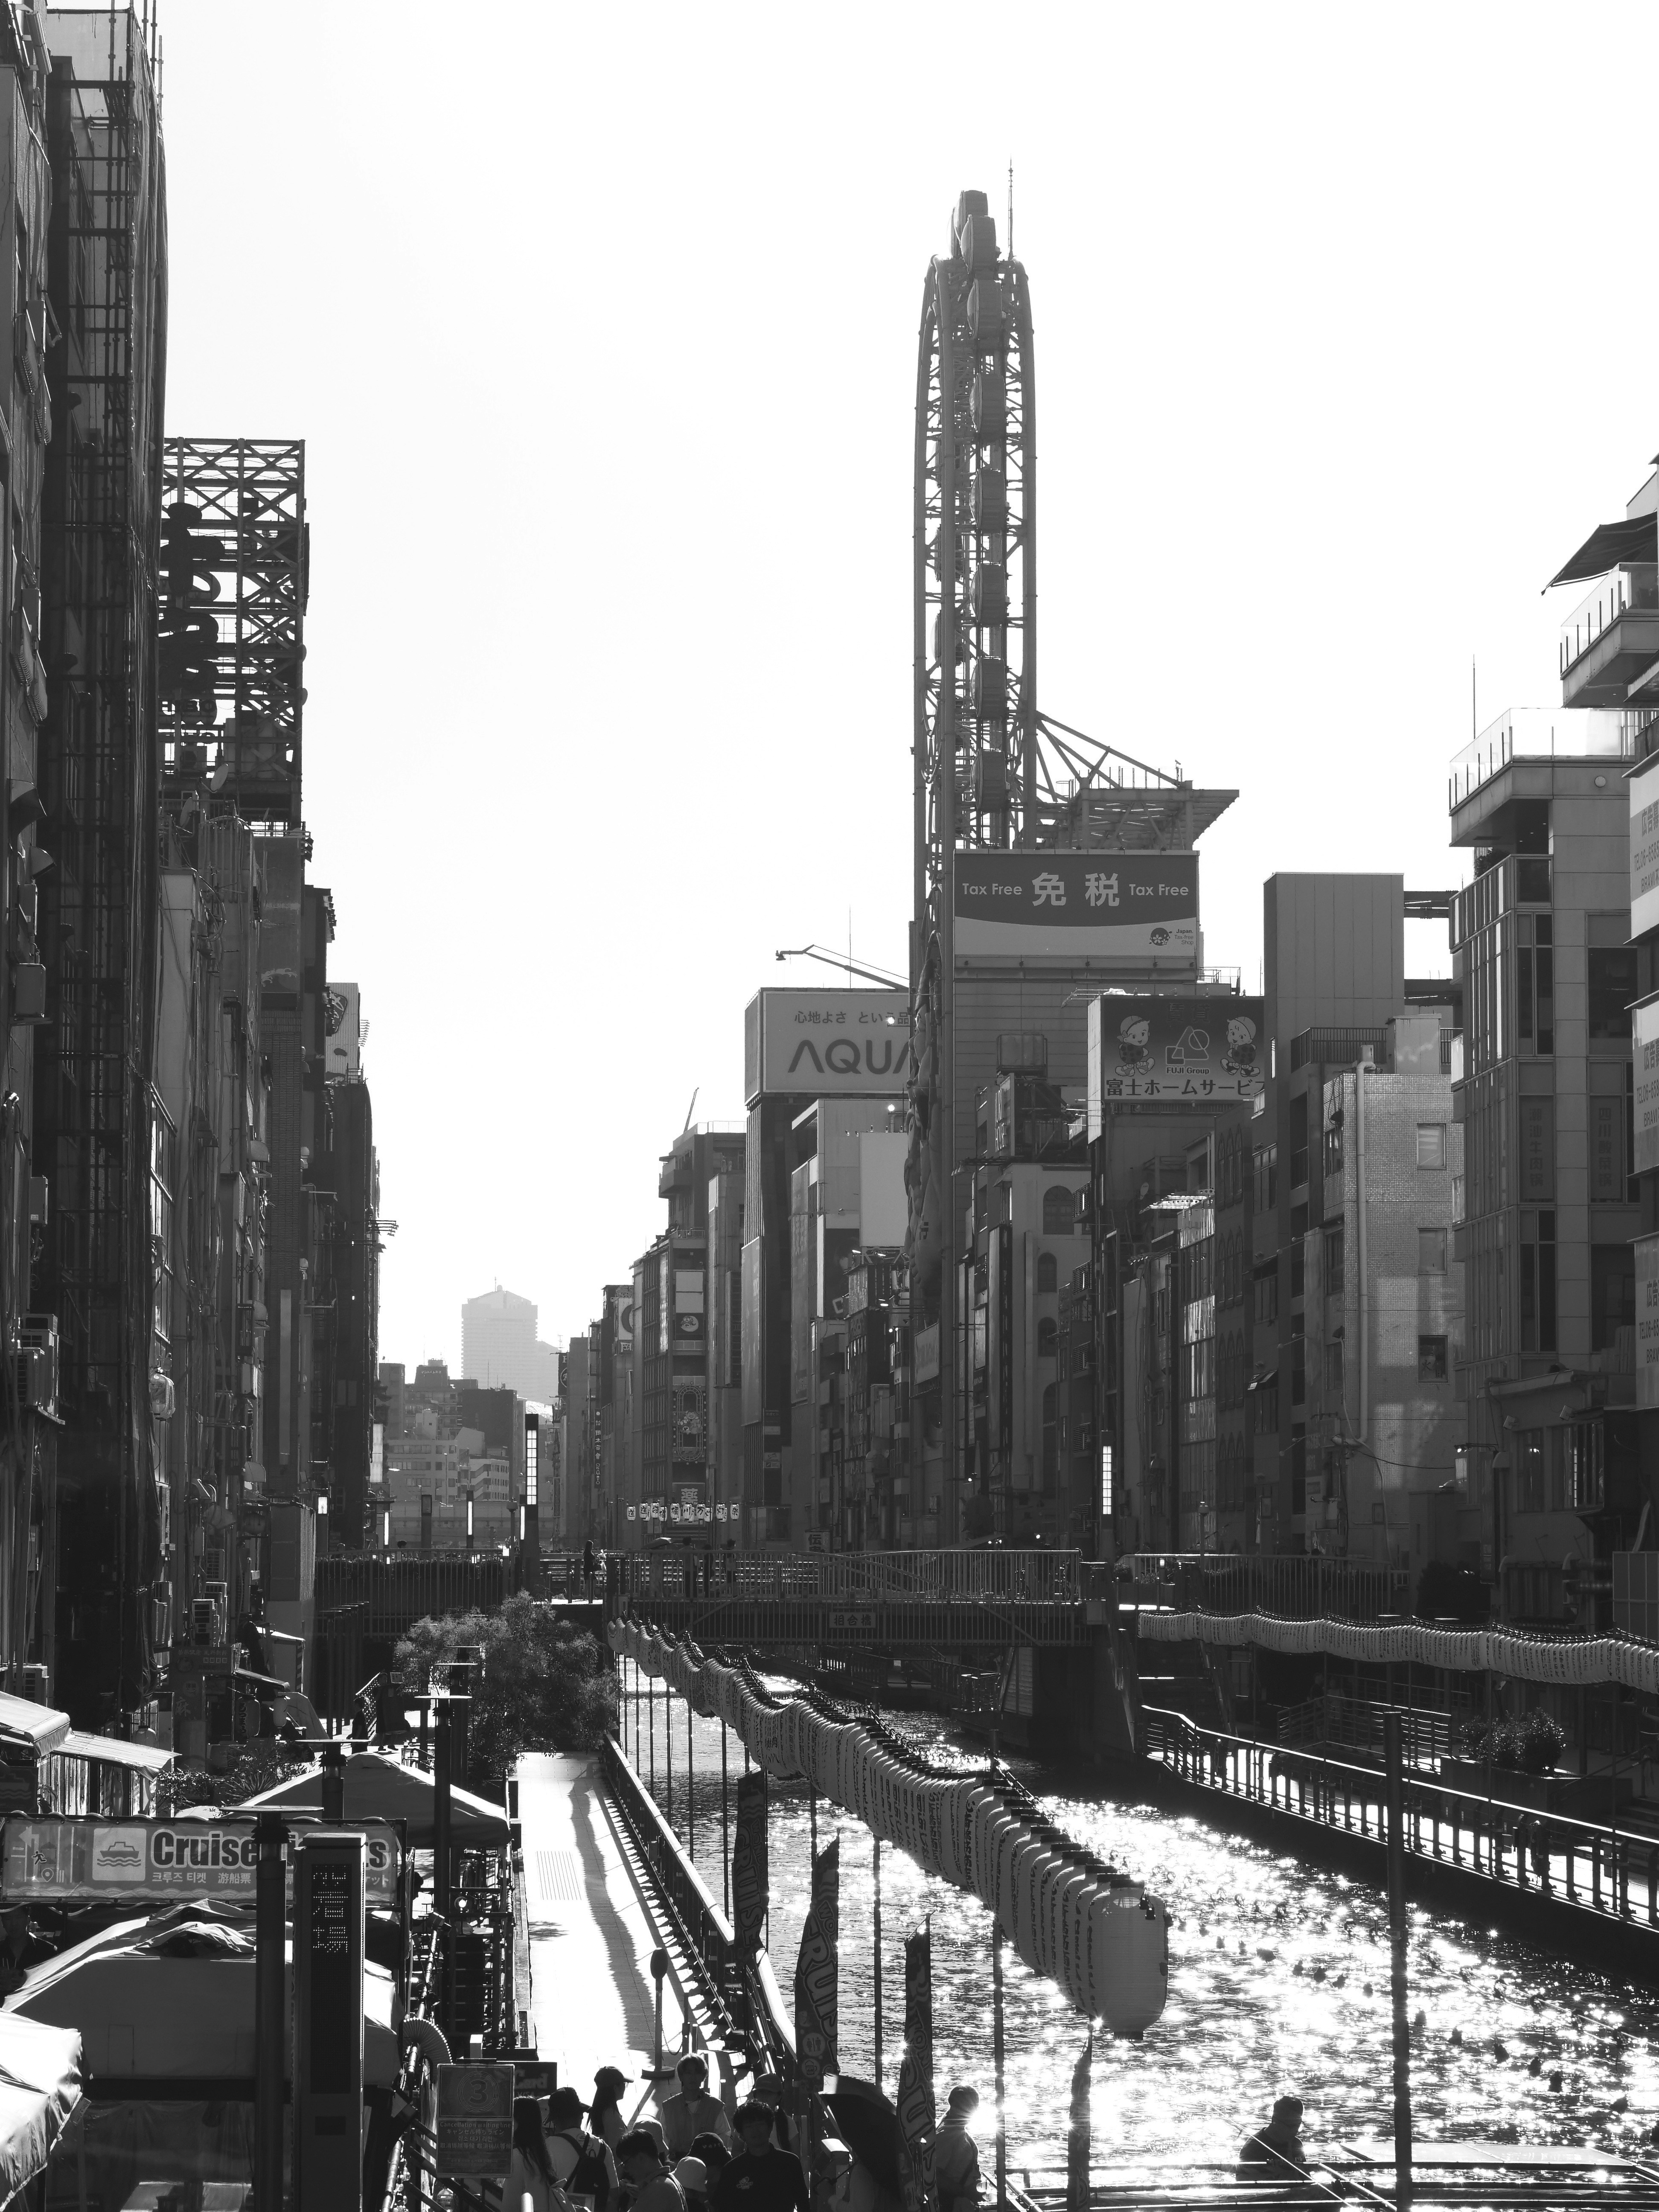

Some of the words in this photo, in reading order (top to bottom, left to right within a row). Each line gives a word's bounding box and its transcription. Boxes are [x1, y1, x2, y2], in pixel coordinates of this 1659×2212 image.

[962, 883, 987, 895] Tax
[992, 883, 1022, 895] Free
[1032, 872, 1120, 907] 免税
[1129, 884, 1154, 896] Tax
[1158, 884, 1189, 896] Free
[794, 1011, 847, 1024] 心地よさ
[1187, 1067, 1210, 1075] Group
[1644, 1107, 1659, 1127] BRAVI
[1647, 1279, 1659, 1308] 広告
[1647, 1347, 1659, 1364] BRAV
[152, 1831, 256, 1868] Cruise
[152, 1871, 183, 1883] 크루즈
[186, 1871, 207, 1884] 티켓
[218, 1872, 251, 1884] 游船票
[469, 2080, 488, 2104] 3
